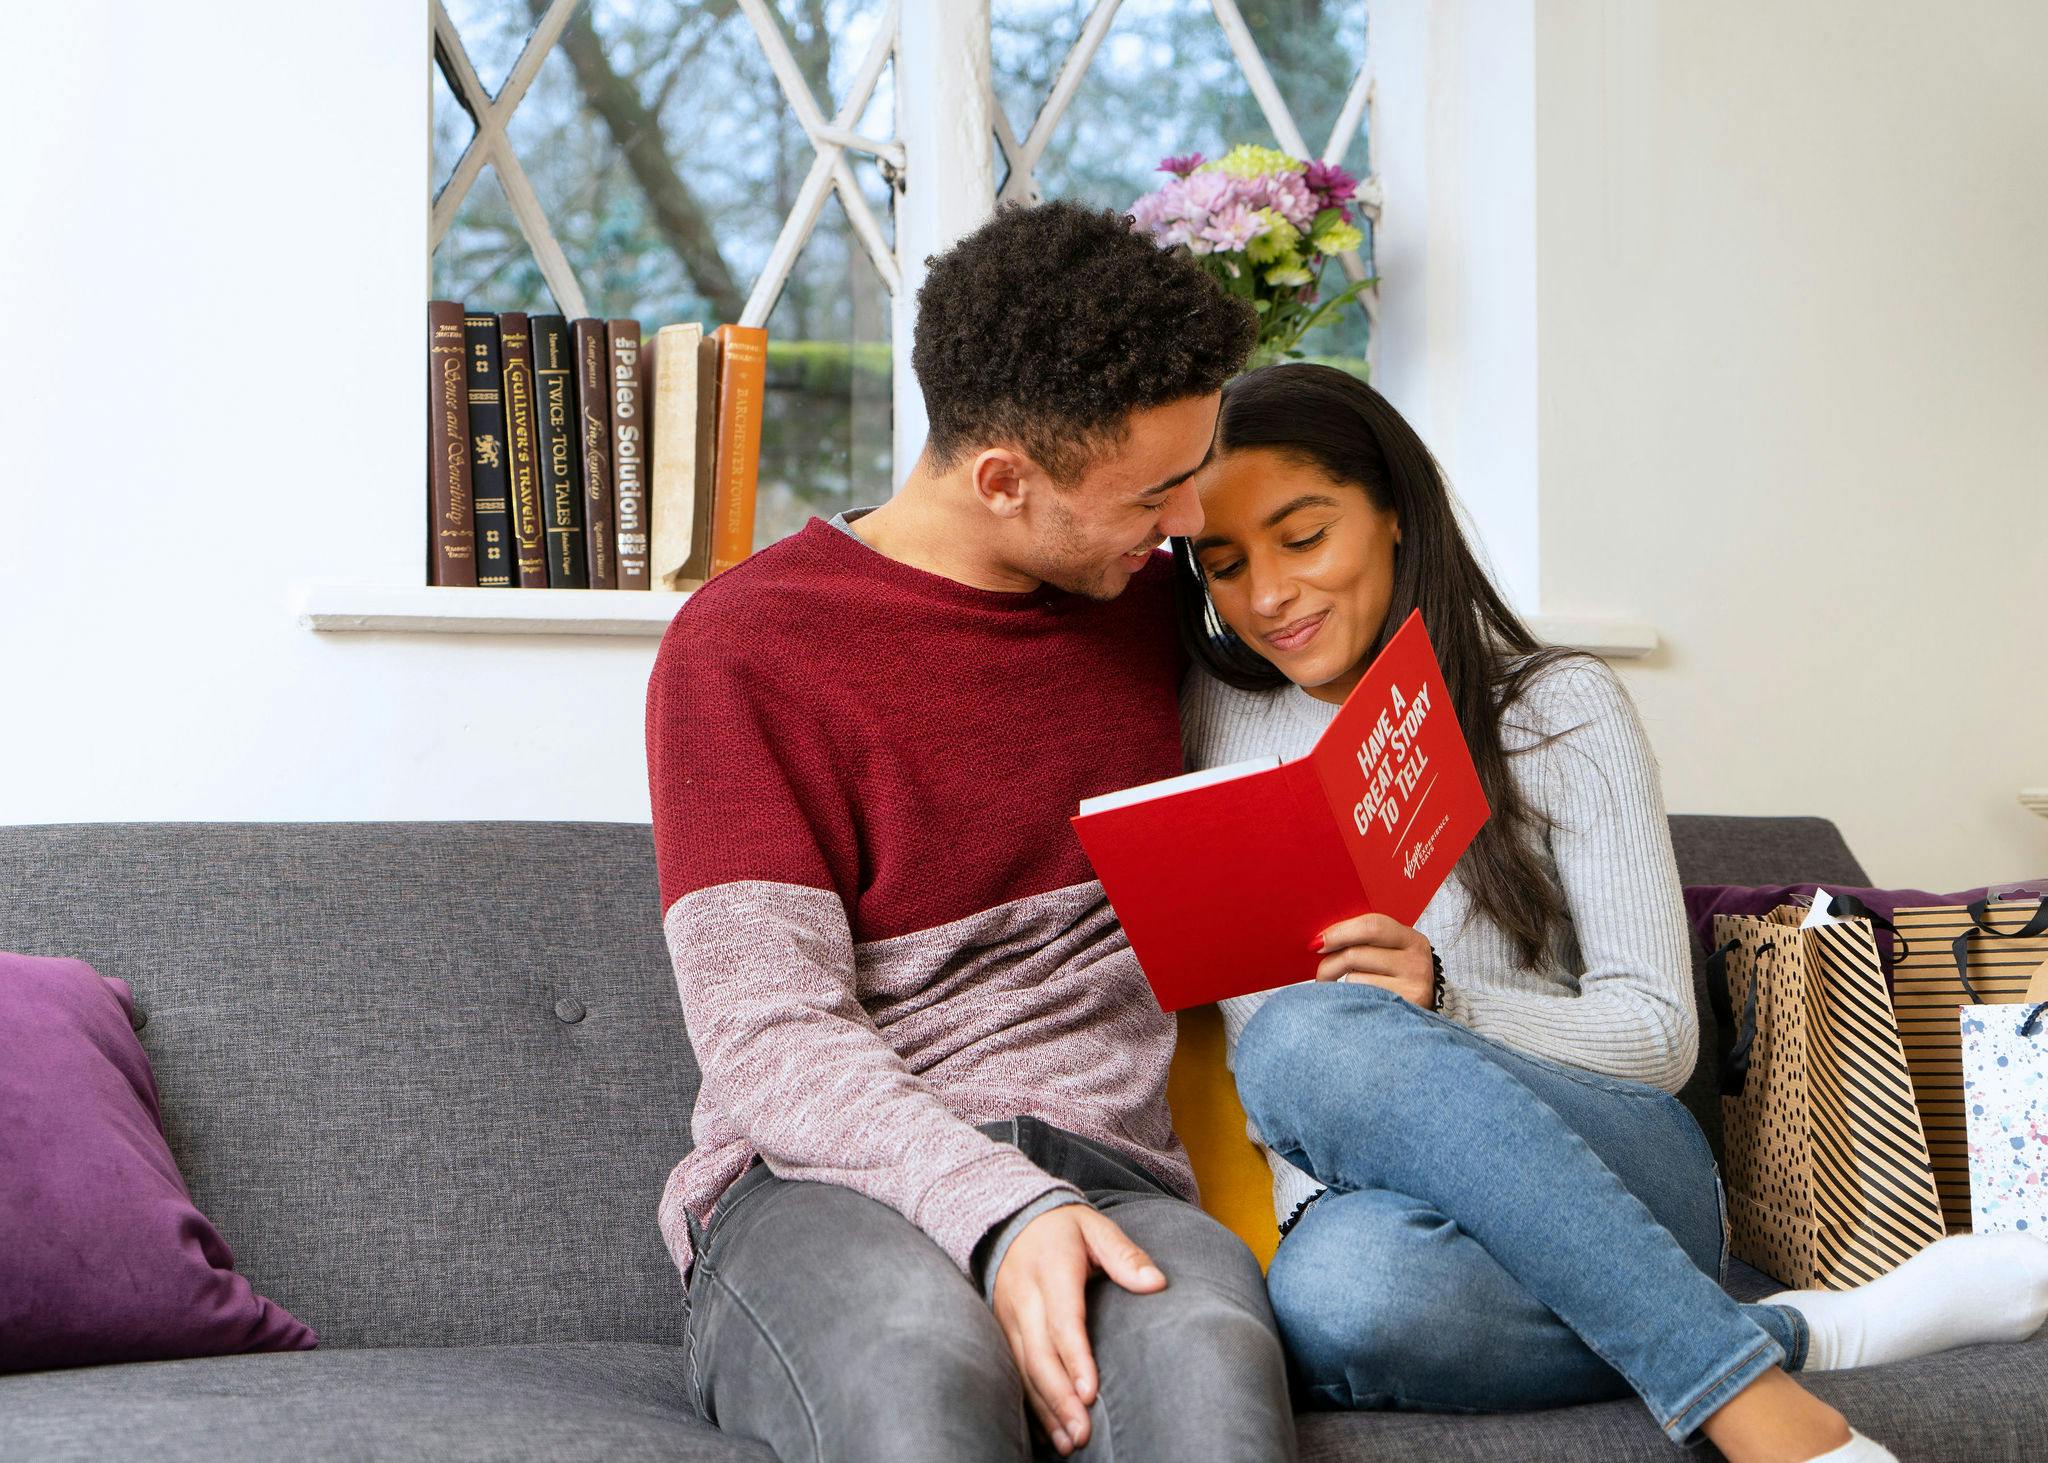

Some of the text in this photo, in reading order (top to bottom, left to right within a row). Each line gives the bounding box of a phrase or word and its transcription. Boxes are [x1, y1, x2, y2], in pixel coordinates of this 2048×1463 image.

[615, 336, 637, 349] the
[444, 358, 466, 525] Sense and Sensibility
[584, 406, 606, 500] Frankenstein
[615, 349, 642, 530] Paleo Solution
[728, 388, 749, 535] BARCHESTER TOWERS
[554, 480, 571, 526] TALES
[618, 544, 646, 555] WOLF
[1353, 682, 1432, 836] GREAT STORY
[1356, 683, 1406, 780] HAVE A
[1377, 745, 1428, 835] TO TELL
[1404, 842, 1422, 880] Virgin
[1419, 814, 1450, 860] EXPERIENCE
[1421, 845, 1434, 866] DAYS
